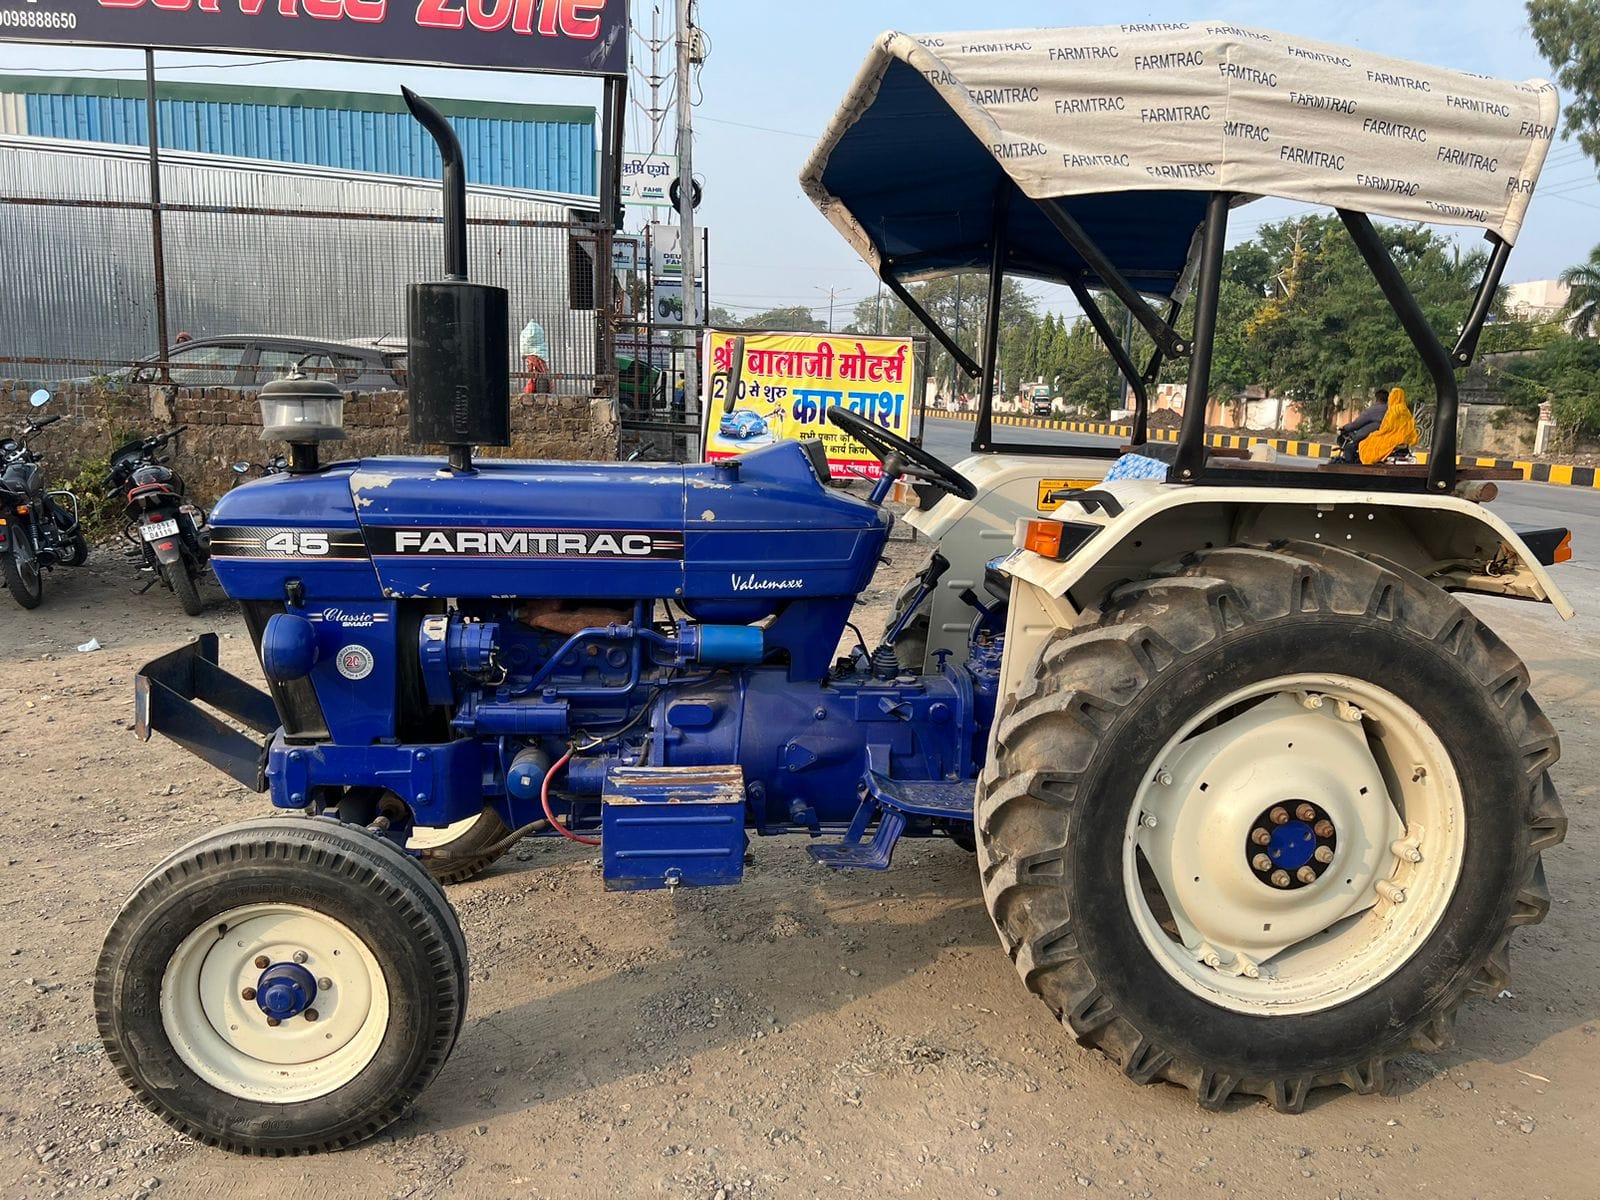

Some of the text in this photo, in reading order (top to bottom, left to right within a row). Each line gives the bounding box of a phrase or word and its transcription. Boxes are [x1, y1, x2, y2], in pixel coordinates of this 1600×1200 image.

[0, 10, 77, 29] 098888650
[1120, 22, 1190, 33] FARMTRAC
[1049, 46, 1119, 61] FARMTRAC
[1134, 50, 1204, 70] FARMTRAC
[1287, 45, 1352, 68] FARMTRAC
[1366, 70, 1431, 93] FARMTRAC
[968, 86, 1039, 105] FARMTRAC
[1055, 96, 1125, 114] FARMTRAC
[1289, 91, 1358, 115] FARMTRAC
[1446, 95, 1510, 118] FARMTRAC
[1141, 105, 1211, 123] FARMTRAC
[1362, 118, 1427, 143] FARMTRAC
[1063, 153, 1130, 168] FARMTRAC
[1280, 145, 1345, 171] FARMTRAC
[1436, 146, 1498, 173] FARMTRAC
[1146, 162, 1216, 179] FARMTRAC
[1356, 173, 1420, 197] FARMTRAC
[747, 341, 834, 379] बालाजी
[839, 342, 908, 383] मोटर्स
[713, 378, 746, 400] 20
[749, 380, 760, 397] से
[265, 531, 330, 555] 45
[395, 531, 652, 555] FARMTRAC
[731, 573, 803, 591] Valuemaxx
[323, 607, 372, 622] Classic
